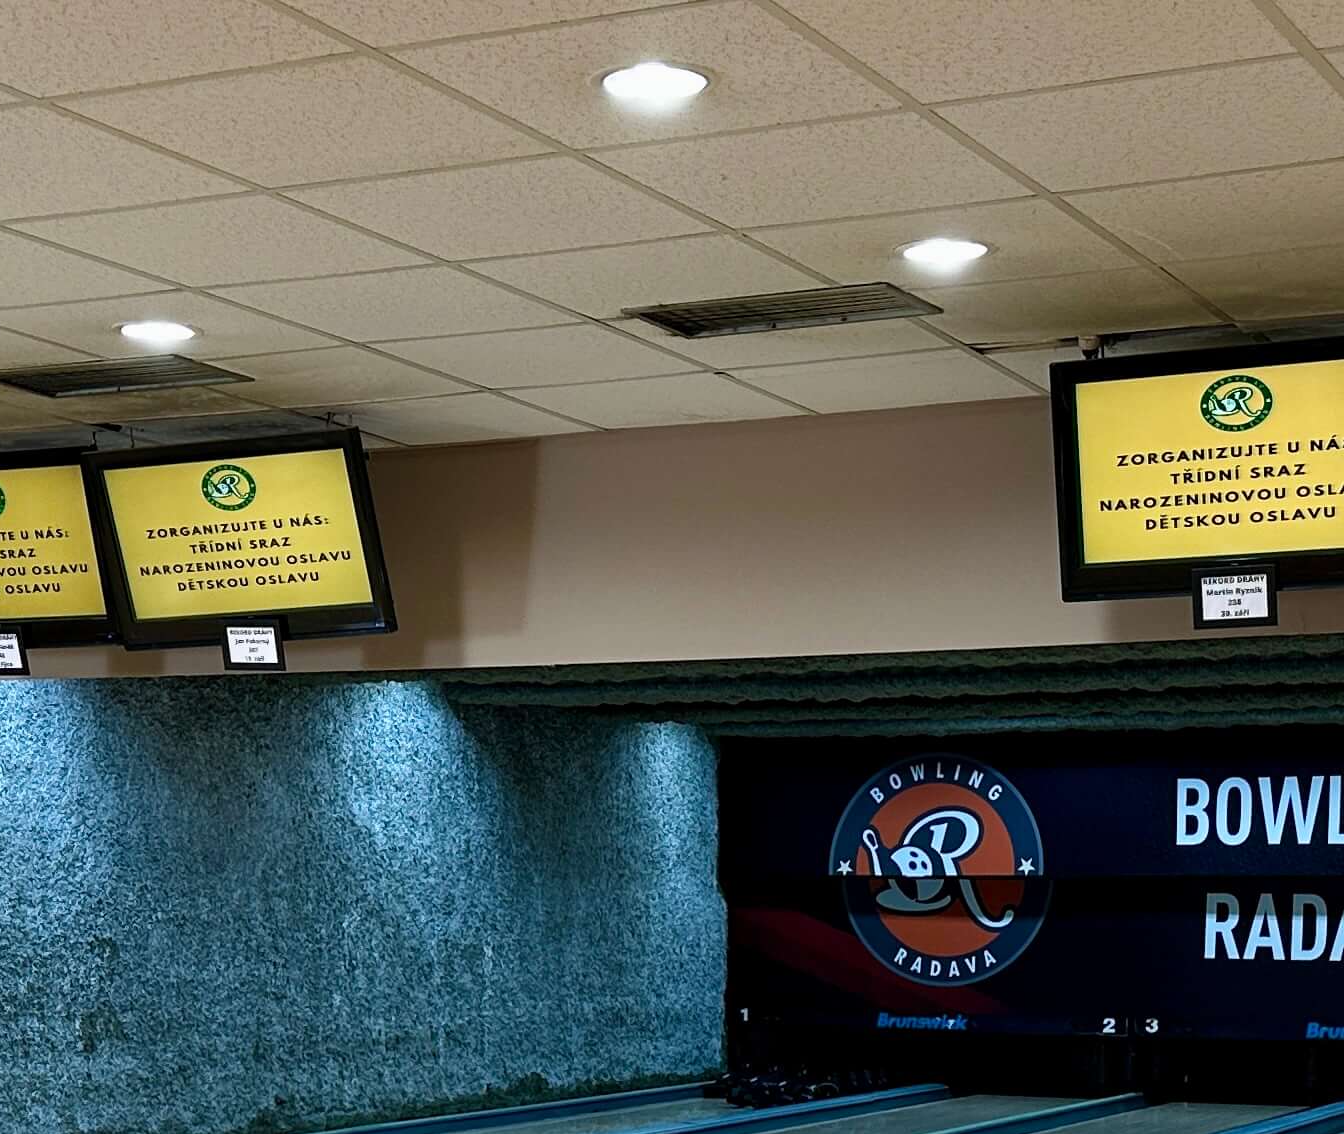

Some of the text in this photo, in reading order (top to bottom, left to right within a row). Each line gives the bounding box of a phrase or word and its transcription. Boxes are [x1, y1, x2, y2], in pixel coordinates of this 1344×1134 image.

[1116, 442, 1278, 467] ZORGANIZUJTE
[1287, 440, 1300, 454] U
[1170, 463, 1307, 485] TŘÍDNÍ SRAZ
[1099, 487, 1286, 512] NAROZENINOVOU
[146, 513, 329, 539] ZORGANIZUJTE U NÁS:
[1145, 506, 1337, 531] DĚTSKOU OSLAVU
[20, 530, 29, 540] U
[189, 536, 291, 554] TŘÍDNÍ SRAZ
[0, 548, 36, 559] SRAZ
[140, 550, 351, 576] NAROZENINOVOU OSLAVU
[31, 563, 88, 575] OSLAVU
[5, 582, 61, 594] OSLAVU
[177, 572, 319, 592] DĚTSKOU OSLAVU
[870, 762, 1003, 803] BOWLING
[893, 947, 997, 978] RADAVA
[740, 1008, 749, 1022] 1
[1145, 1017, 1159, 1033] 3
[1102, 1018, 1116, 1033] 2
